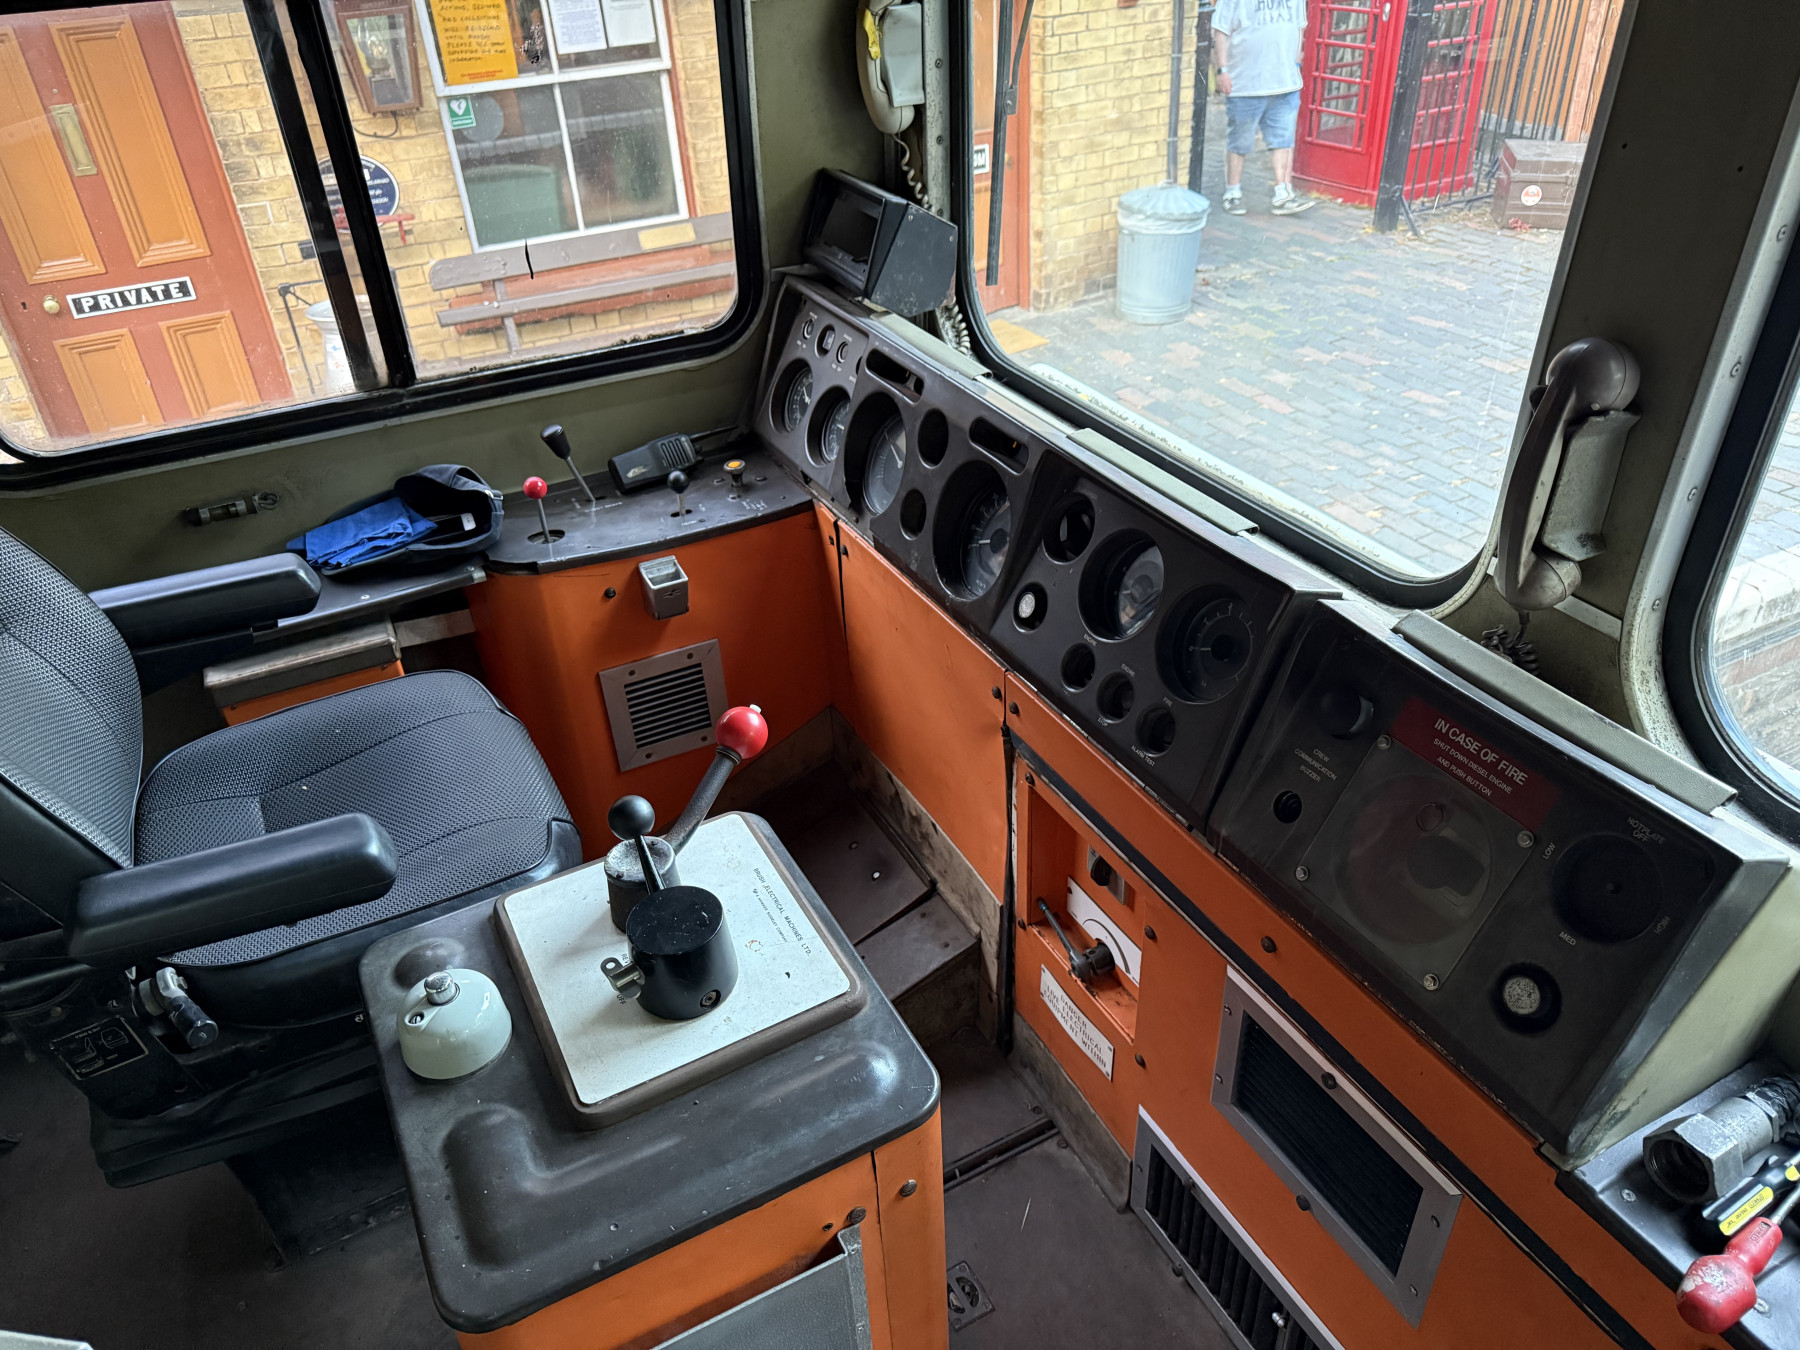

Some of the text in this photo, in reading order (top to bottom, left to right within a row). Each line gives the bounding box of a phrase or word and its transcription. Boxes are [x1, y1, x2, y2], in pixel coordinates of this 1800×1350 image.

[81, 282, 184, 313] PRIVATE
[1144, 755, 1155, 767] TEST
[1294, 748, 1337, 781] COMMUNICATION
[1313, 748, 1330, 762] CREW
[1433, 738, 1513, 794] SHUT DOWN DIESEL ENGINE
[1434, 718, 1528, 786] IN CASE OF FIRE
[1299, 764, 1322, 783] BUZZER
[1437, 757, 1493, 796] AND PUSH BUTTON
[1627, 817, 1665, 845] HOTPLATE
[1633, 830, 1650, 842] OFF
[1542, 842, 1556, 859] LOW
[753, 868, 811, 956] BRUSH ELECTRICAL MACHINES LTD.
[1559, 931, 1577, 946] MED
[617, 994, 626, 1005] OFF
[1043, 989, 1079, 1038] EQUIPMENT
[1060, 995, 1087, 1028] DANGER
[1046, 986, 1103, 1055] LIVE ELECTRICAL
